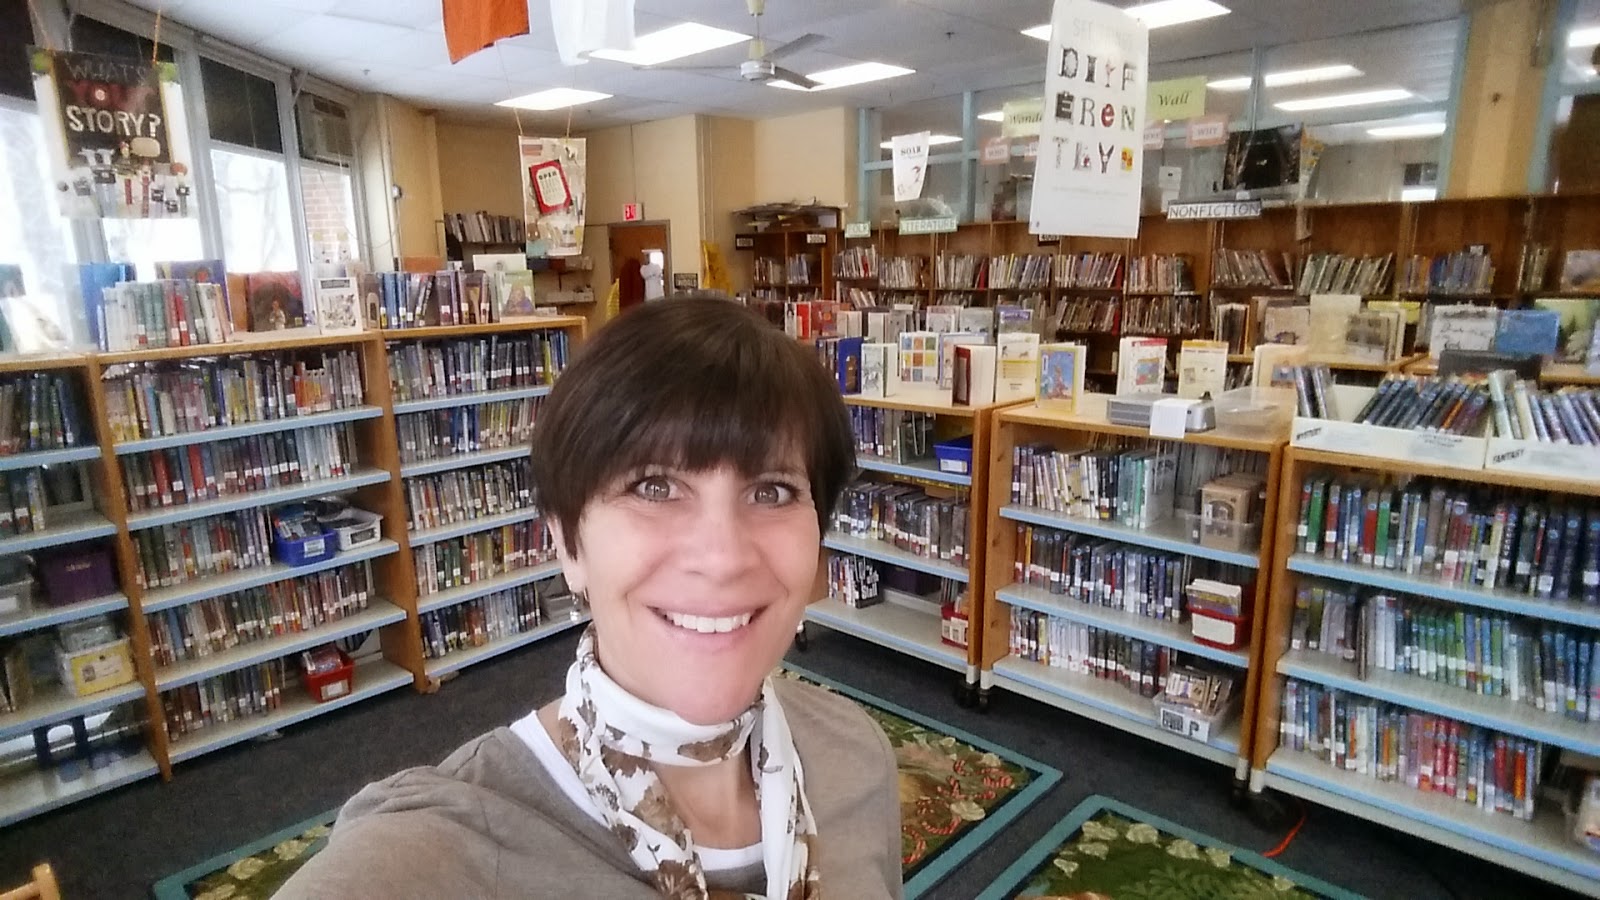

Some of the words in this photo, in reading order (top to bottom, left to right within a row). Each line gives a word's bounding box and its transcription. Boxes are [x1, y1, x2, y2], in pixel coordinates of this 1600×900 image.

[1157, 90, 1192, 106] Wall
[65, 104, 162, 138] STORY?
[1169, 203, 1260, 219] NONFICTION
